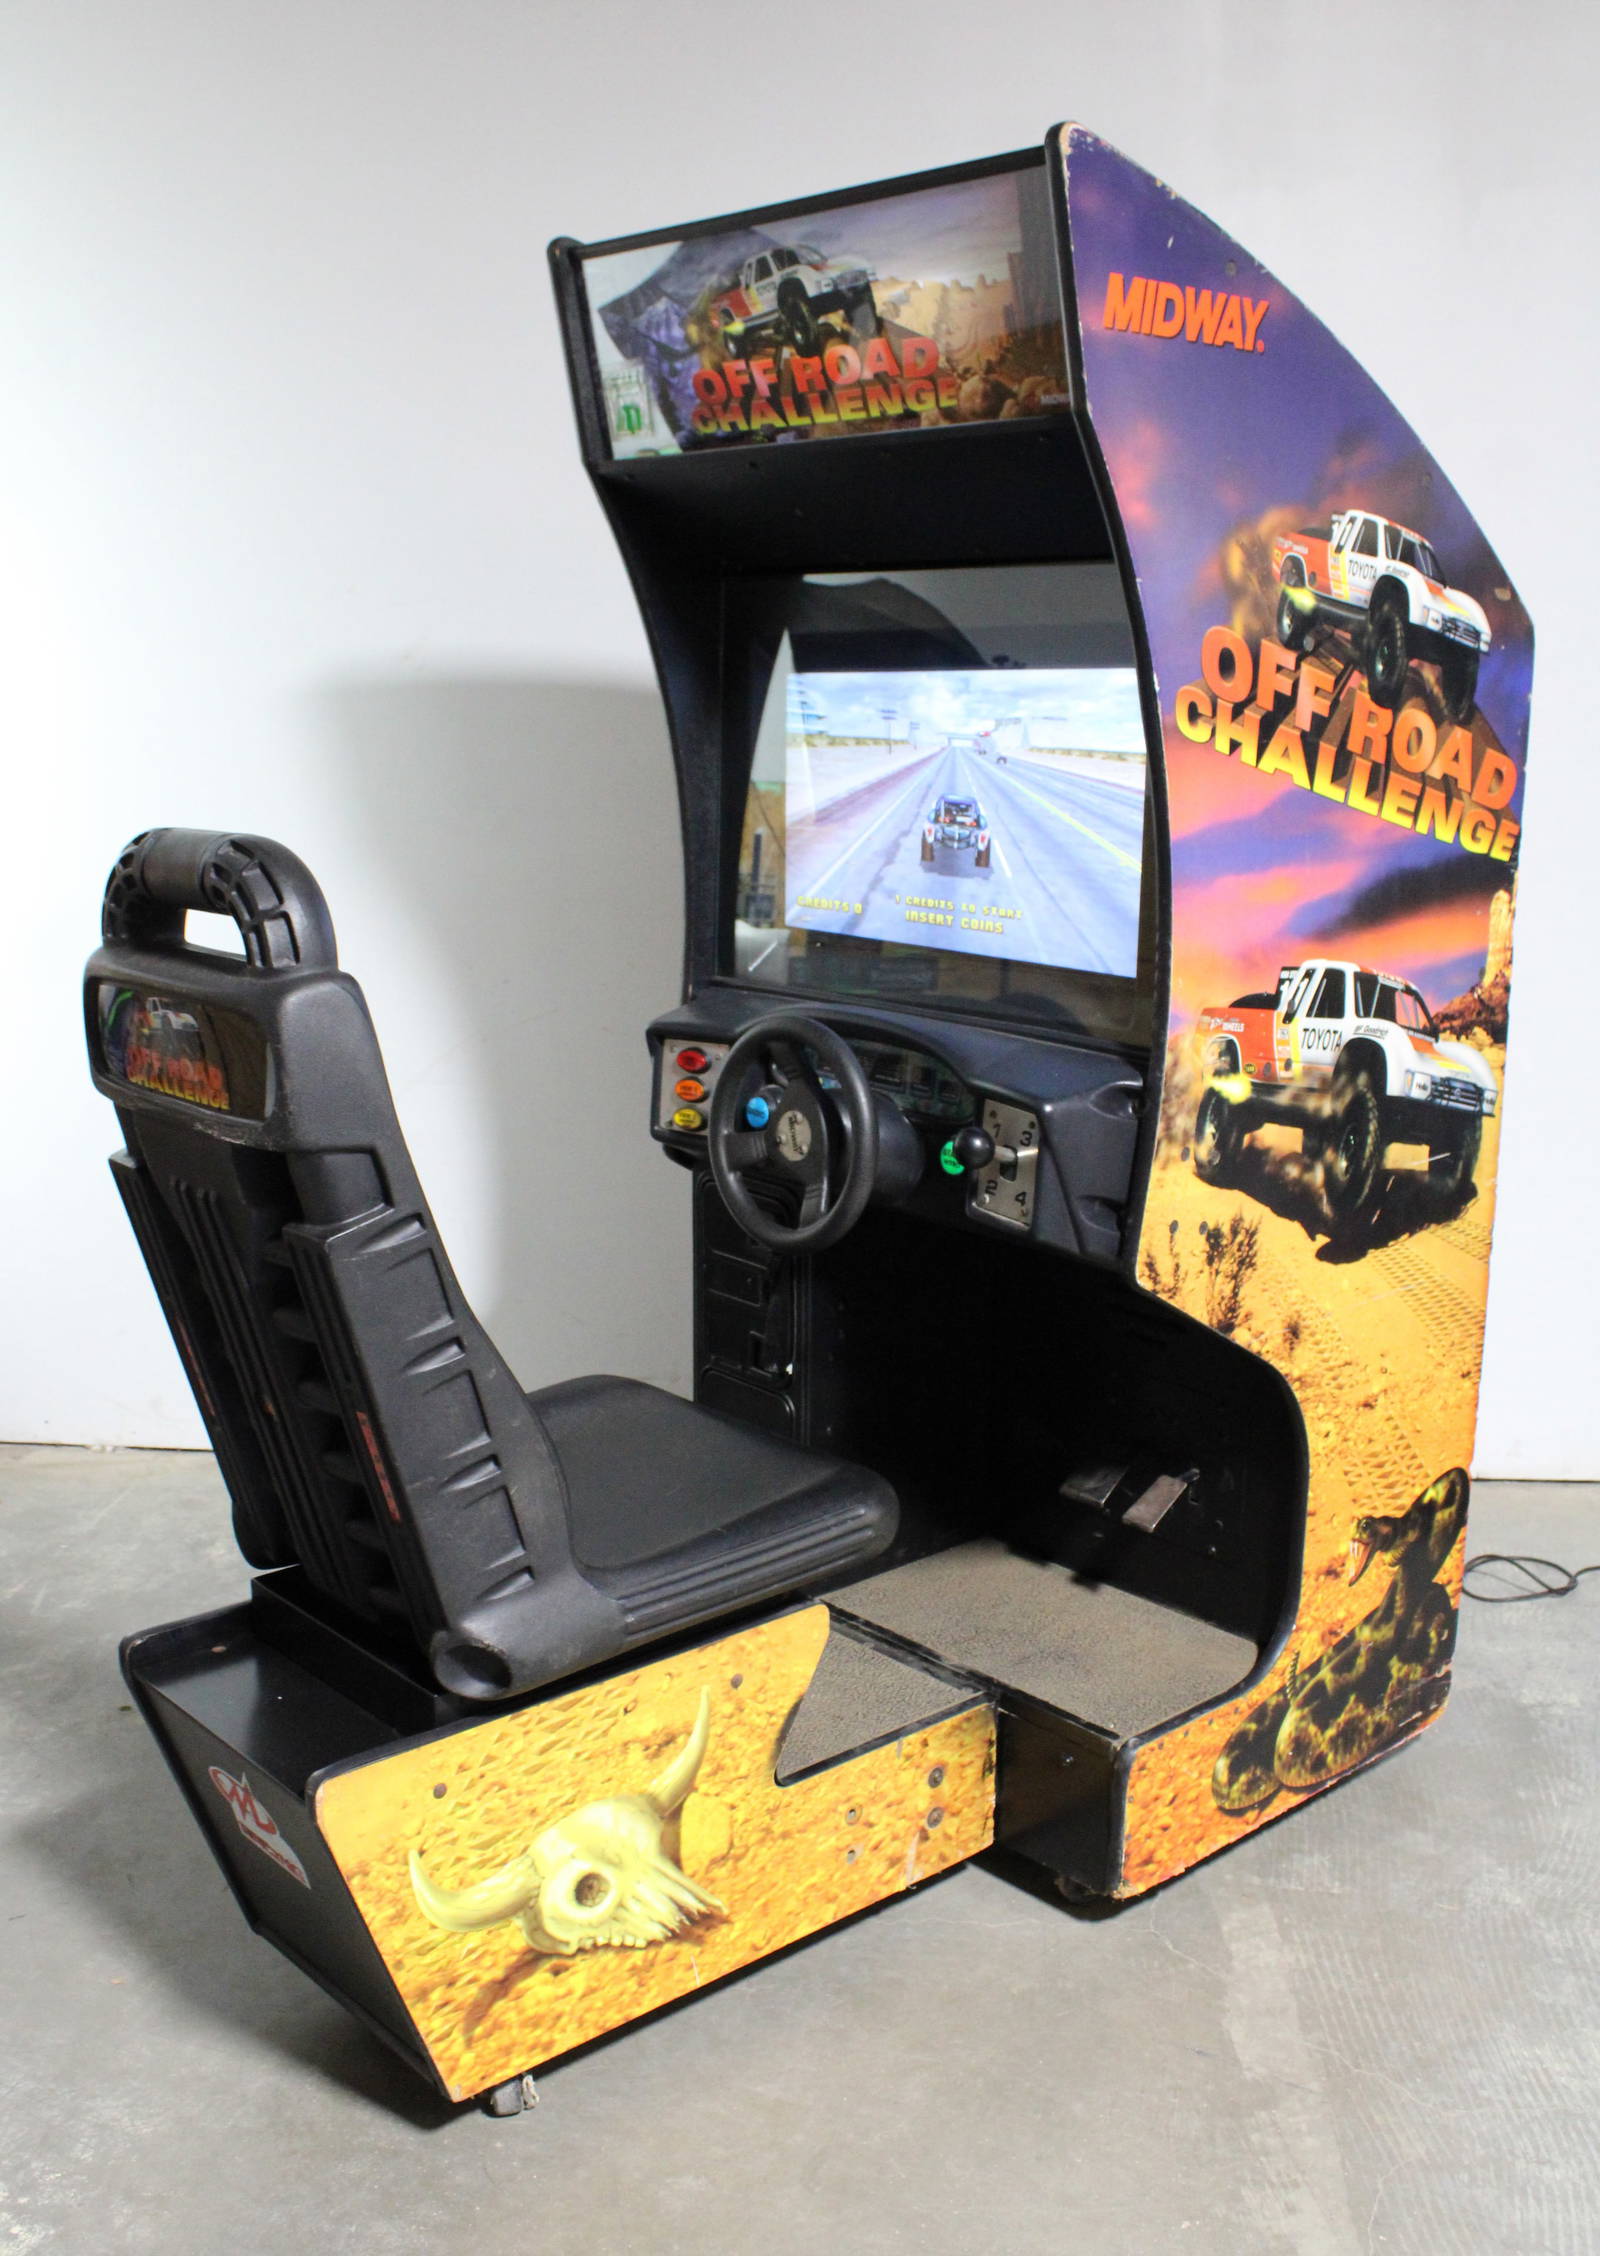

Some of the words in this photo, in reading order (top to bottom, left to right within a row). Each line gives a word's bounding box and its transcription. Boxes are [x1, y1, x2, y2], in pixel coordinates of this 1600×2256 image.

[693, 359, 777, 404] OFF
[793, 337, 940, 394] ROAD
[692, 377, 959, 435] CHALLENGE
[1348, 559, 1377, 581] TOYOTA
[1202, 626, 1335, 732] OFF
[1346, 688, 1517, 811] ROAD
[1175, 685, 1521, 862] CHALLENGE
[797, 896, 849, 912] CREDITS
[905, 895, 955, 911] CREDITS
[905, 910, 954, 926] INSERT
[961, 917, 1004, 934] COINS
[1301, 1028, 1343, 1053] TOYOTA
[1019, 1130, 1033, 1147] 3
[985, 1179, 998, 1197] 2
[1015, 1191, 1028, 1206] 4
